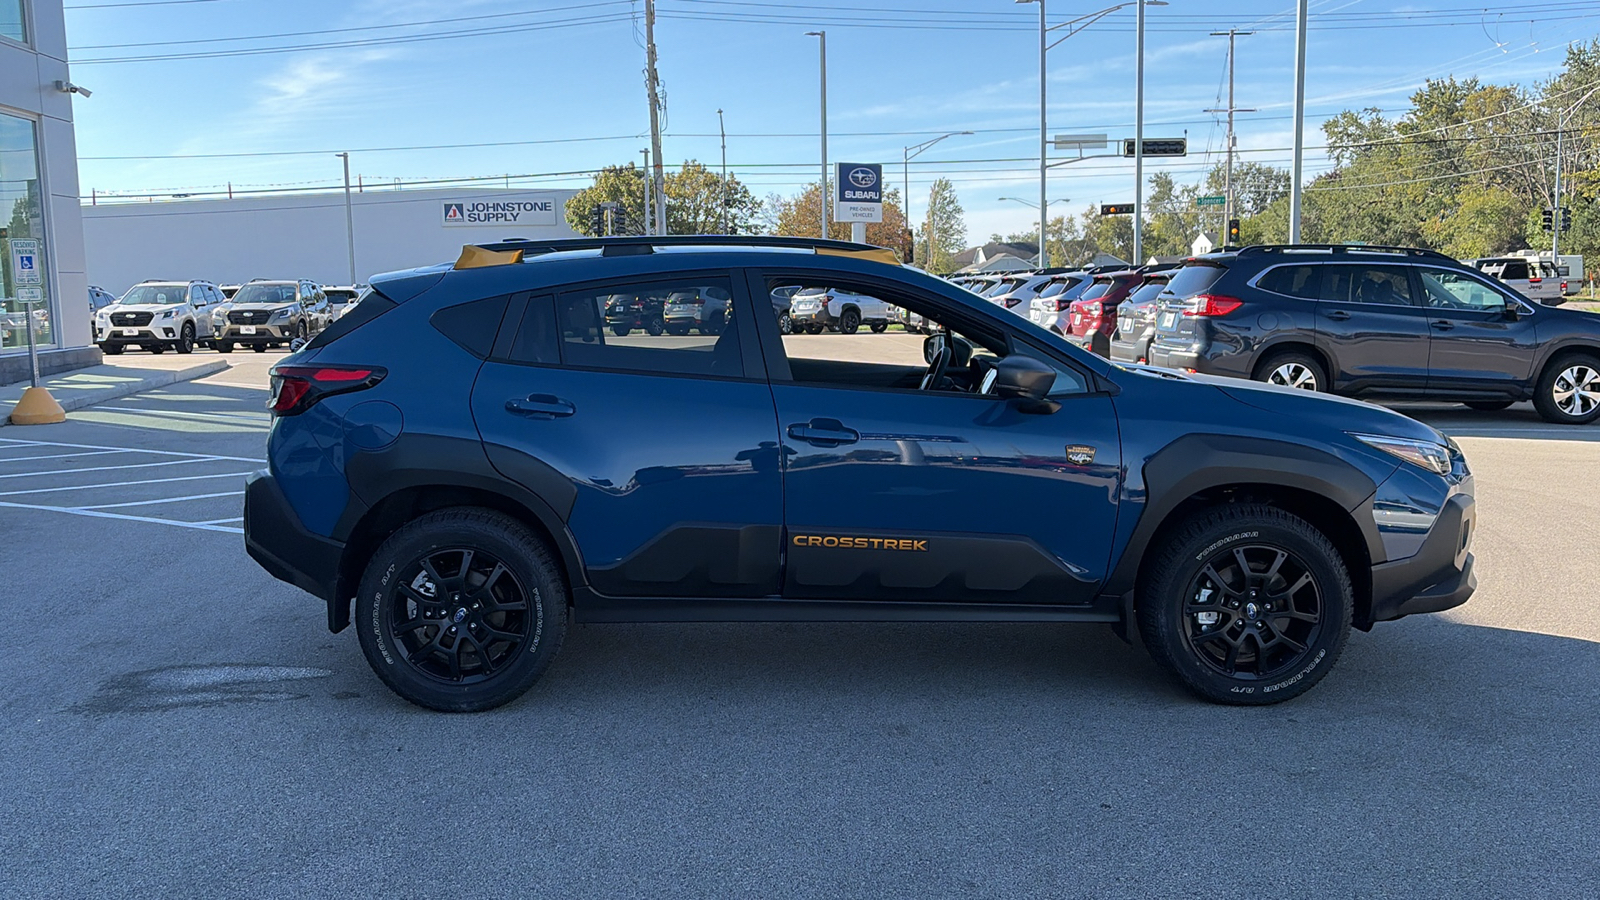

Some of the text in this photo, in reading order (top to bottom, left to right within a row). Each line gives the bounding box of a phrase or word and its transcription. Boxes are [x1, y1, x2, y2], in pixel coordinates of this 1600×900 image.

[844, 190, 879, 199] SUBARU
[467, 202, 552, 212] JOHNSTONE
[467, 212, 520, 222] SUPPLY
[793, 535, 928, 551] CROSSTREK
[1195, 531, 1259, 561] YOKOHAMA
[373, 592, 394, 665] GEOLANDAR
[530, 587, 544, 653] YOKOHAMA
[1230, 648, 1326, 694] GEOLANDAR A/T
